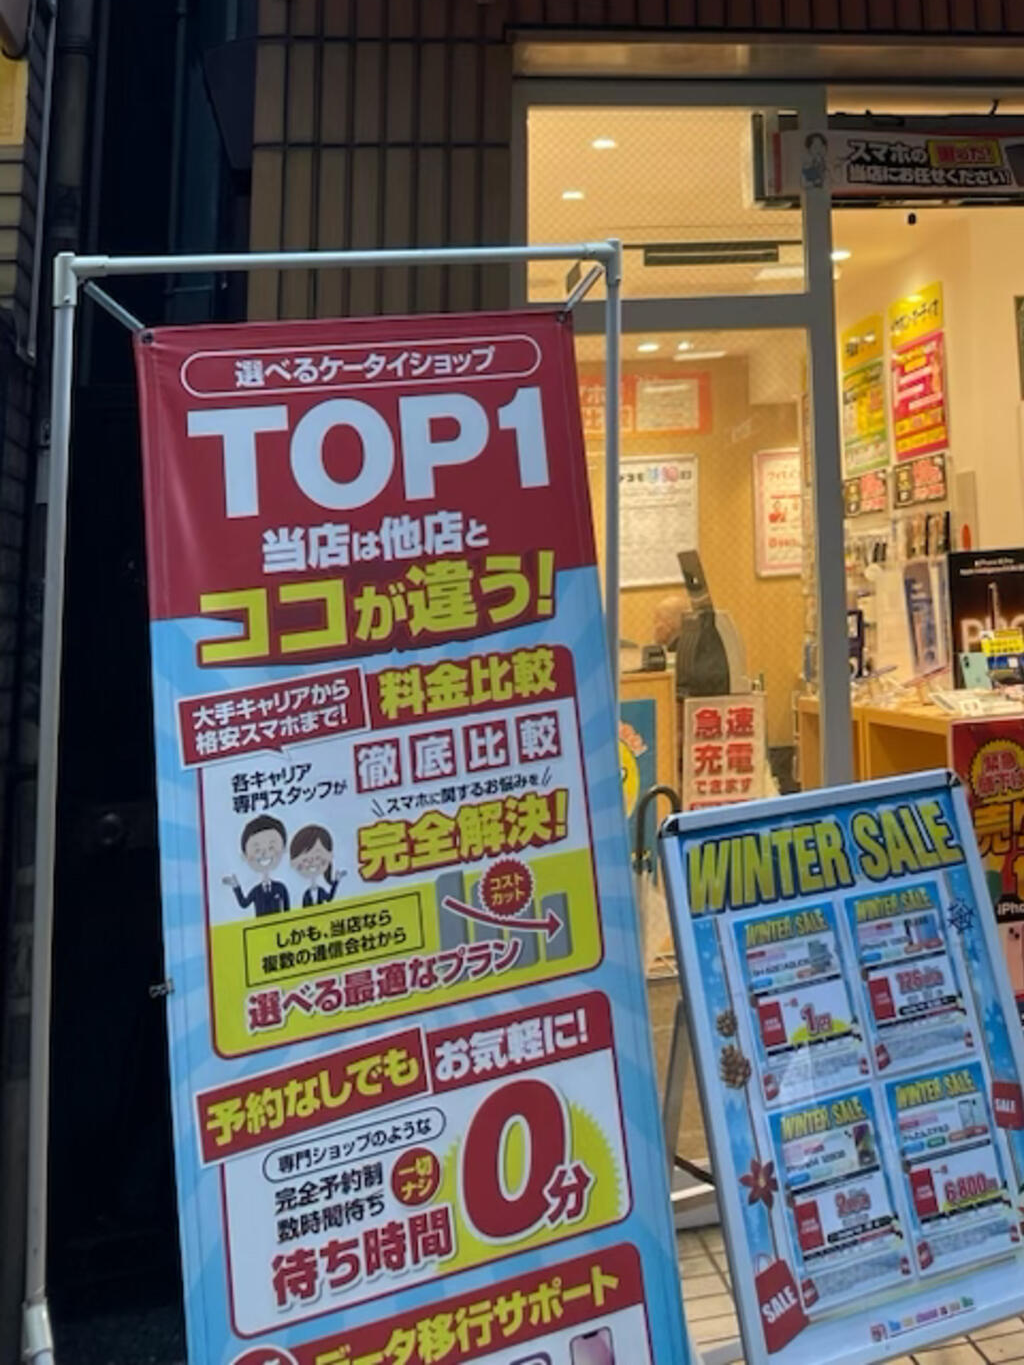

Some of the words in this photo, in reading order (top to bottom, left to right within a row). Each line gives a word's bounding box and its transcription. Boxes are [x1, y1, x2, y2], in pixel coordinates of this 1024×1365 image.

[850, 140, 927, 164] スマホの
[235, 346, 495, 388] 選べるケータイショップ
[187, 387, 550, 518] TOP1
[262, 511, 489, 574] 当店は他店と
[200, 551, 555, 664] ココが違う!
[192, 679, 350, 730] 大手キャリアから
[379, 650, 558, 720] 料金比較
[196, 707, 348, 754] 格安スマホまで!
[695, 707, 755, 739] 急速
[357, 714, 559, 789] 徹底比較
[695, 743, 755, 776] 充電
[232, 763, 312, 792] 各キャリア
[232, 779, 347, 813] 専門スタッフが
[386, 774, 538, 813] スマホに関するお悩みを
[695, 778, 752, 794] できます
[359, 791, 568, 879] 完全解決!
[688, 820, 855, 916] WINTER
[851, 800, 965, 881] SALE
[489, 873, 523, 892] コスト
[491, 888, 525, 907] カット
[856, 893, 898, 922] WINTER
[900, 887, 934, 911] SALE
[745, 917, 793, 948] WINTER
[796, 908, 829, 934] SALE
[262, 928, 407, 973] 複数の通信会社から
[247, 941, 523, 1029] 選べる最適なプラン
[434, 1009, 588, 1081] お気軽に!
[207, 1049, 419, 1145] 予約なしでも
[896, 1076, 940, 1107] WINTER
[943, 1070, 976, 1096] SALE
[995, 1098, 1016, 1113] SALE
[781, 1106, 830, 1140] WINTER
[831, 1097, 867, 1126] SALE
[278, 1116, 431, 1174] 専門ショップのような
[398, 1155, 431, 1178] 一切
[463, 1079, 570, 1240] 0
[275, 1165, 383, 1210] 完全予約制
[400, 1178, 432, 1201] ナシ
[277, 1193, 384, 1243] 数時間待ち
[272, 1207, 452, 1305] 待ち時間
[760, 1287, 798, 1323] SALE
